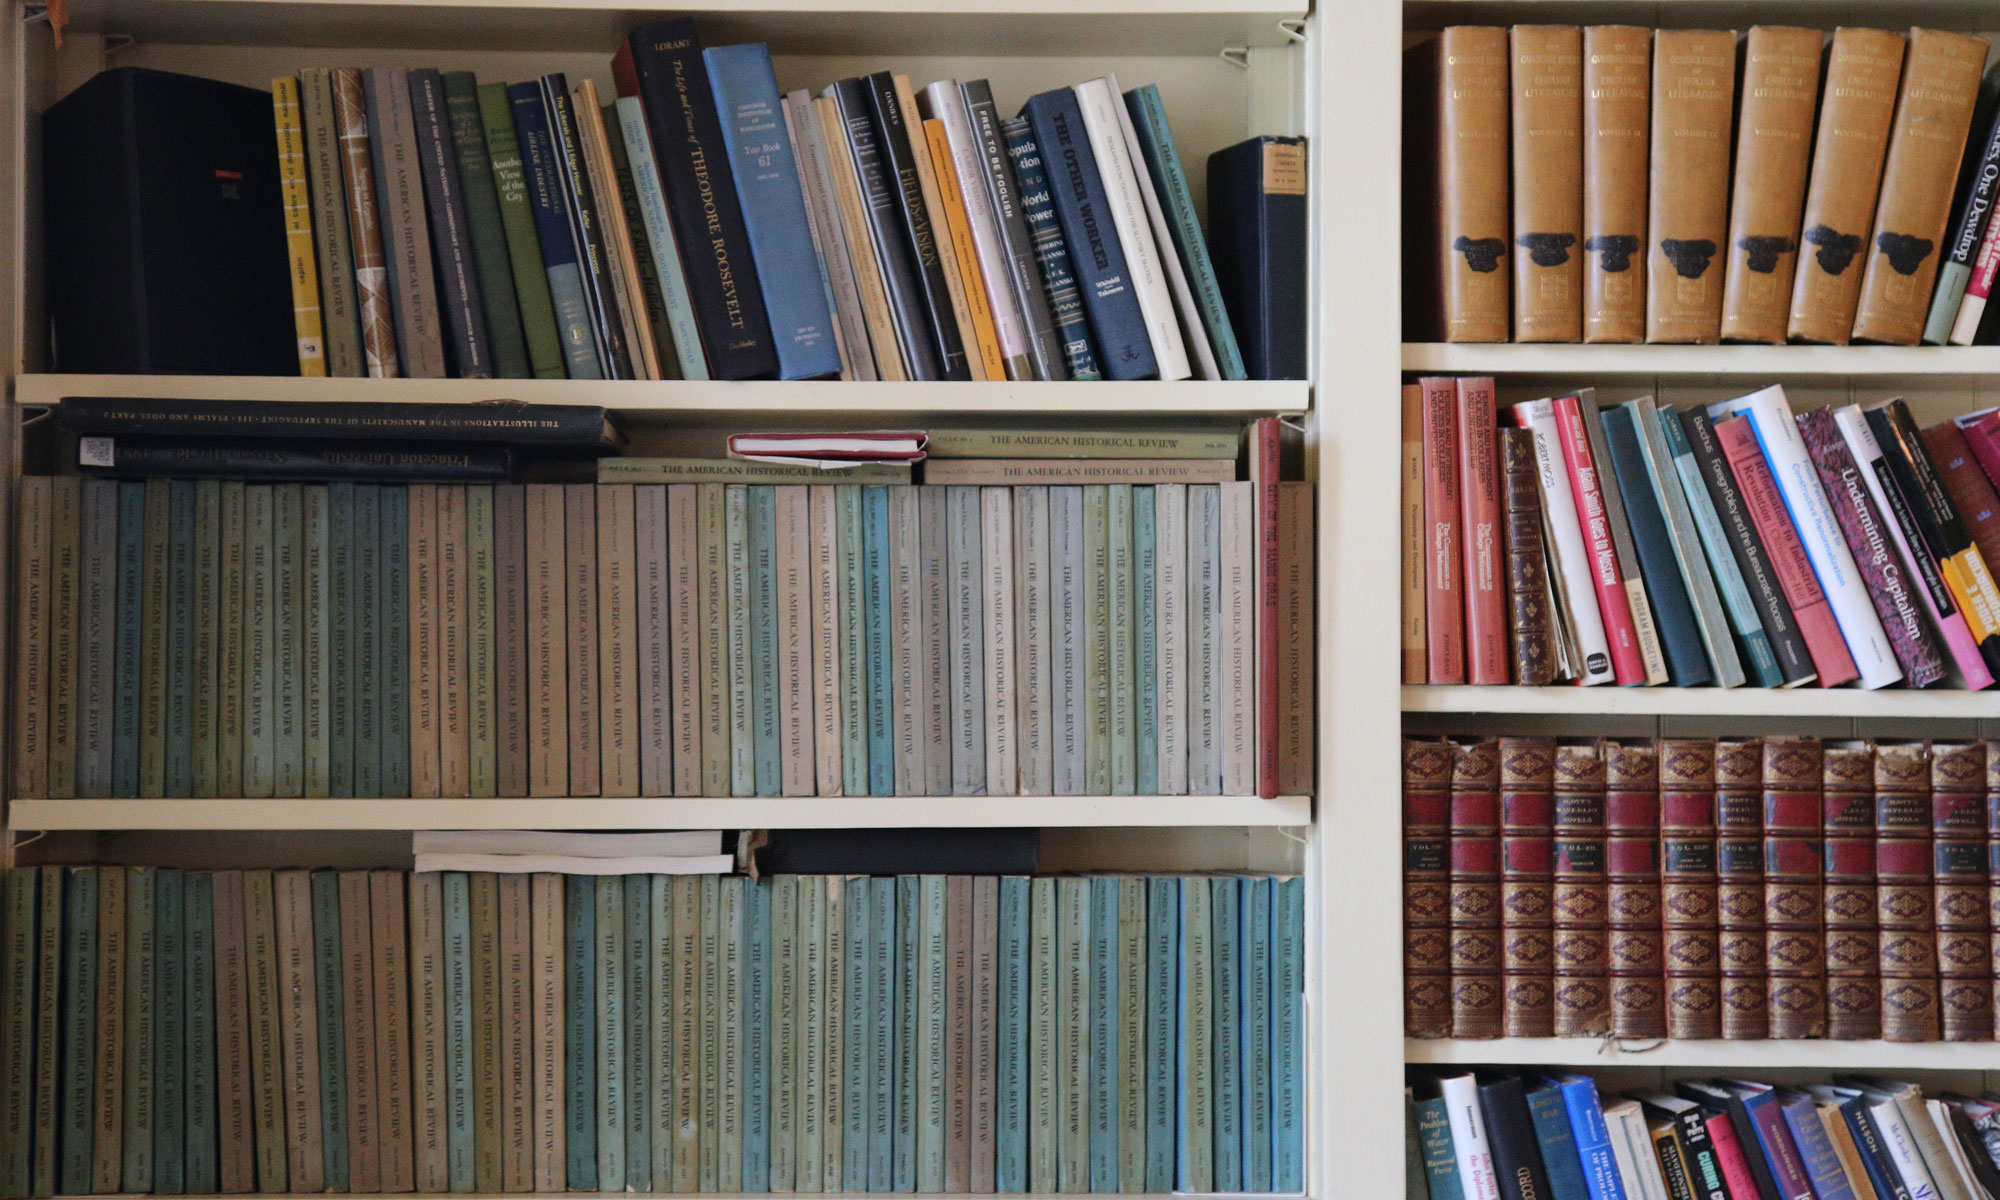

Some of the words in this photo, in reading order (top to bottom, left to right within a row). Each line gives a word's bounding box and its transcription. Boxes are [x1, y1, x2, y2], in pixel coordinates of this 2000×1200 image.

[654, 39, 691, 50] LORANT
[672, 59, 683, 75] The
[675, 76, 687, 92] Life
[679, 93, 690, 108] and
[884, 91, 898, 124] DANIELS
[558, 110, 569, 134] Liberals
[683, 110, 696, 132] Times
[978, 110, 991, 136] FREE
[564, 136, 572, 148] and
[687, 134, 699, 144] of
[986, 140, 996, 154] TO
[1009, 142, 1036, 157] opula
[500, 171, 520, 180] View
[527, 130, 539, 164] AIRLINE
[534, 167, 549, 208] INDUSTRY
[567, 154, 577, 171] Edgar
[758, 155, 771, 166] 61
[991, 157, 1000, 170] BE
[502, 182, 511, 191] of
[512, 180, 524, 189] the
[572, 172, 583, 195] Hoover
[690, 147, 720, 233] THEODORE
[1053, 113, 1070, 146] THE
[1064, 149, 1088, 202] OTHER
[1080, 202, 1108, 270] WORKER
[1978, 164, 1999, 195] One
[506, 192, 522, 202] City
[995, 174, 1012, 217] FOOLISH
[1026, 209, 1053, 223] ower
[1954, 197, 1988, 262] Dewdrop
[588, 244, 600, 274] Princeton
[711, 238, 743, 330] ROOSEVELT
[991, 435, 1011, 444] THE
[1015, 436, 1069, 446] AMERICAN
[1073, 437, 1134, 447] HISTORICAL
[1138, 438, 1178, 448] REVIEW
[1438, 429, 1444, 438] IN
[1693, 415, 1715, 453] Bacchus
[1578, 465, 1596, 490] Adam
[1741, 464, 1773, 522] Revolution
[1584, 491, 1602, 516] Smith
[1802, 459, 1816, 481] From
[1812, 482, 1837, 535] Perturbative
[1833, 536, 1842, 546] to
[1590, 517, 1606, 538] Goes
[1754, 460, 1788, 526] Reformation
[1783, 529, 1792, 541] to
[1789, 544, 1818, 596] Industrial
[1791, 462, 1818, 516] Constructive
[1813, 517, 1847, 586] Renormalization
[309, 548, 318, 568] THE
[732, 541, 740, 561] THE
[1595, 539, 1608, 549] to
[1709, 458, 1730, 491] Foreign
[1720, 489, 1740, 515] Policy
[1732, 514, 1746, 531] and
[1740, 531, 1752, 546] the
[1746, 546, 1773, 598] Bureaucratic
[1765, 596, 1787, 632] Process
[1841, 468, 1888, 564] Undermining
[1882, 565, 1921, 640] Capitalism
[1597, 550, 1617, 586] Moscow
[310, 573, 318, 627] AMERICAN
[733, 566, 742, 619] AMERICAN
[1631, 591, 1648, 628] PROGRAM
[1641, 630, 1660, 674] BUDGETING
[310, 632, 318, 694] HISTORICAL
[734, 625, 743, 686] HISTORICAL
[310, 699, 318, 740] REVIEW
[735, 691, 744, 730] REVIEW
[1071, 941, 1079, 961] THE
[424, 979, 432, 1034] AMERICAN
[1071, 967, 1079, 1020] AMERICAN
[425, 1040, 433, 1101] HISTORICAL
[1070, 1093, 1078, 1133] REVIEW
[426, 1108, 434, 1150] REVIEW
[1855, 1111, 1878, 1153] NELSON
[1698, 1150, 1720, 1190] CURING
